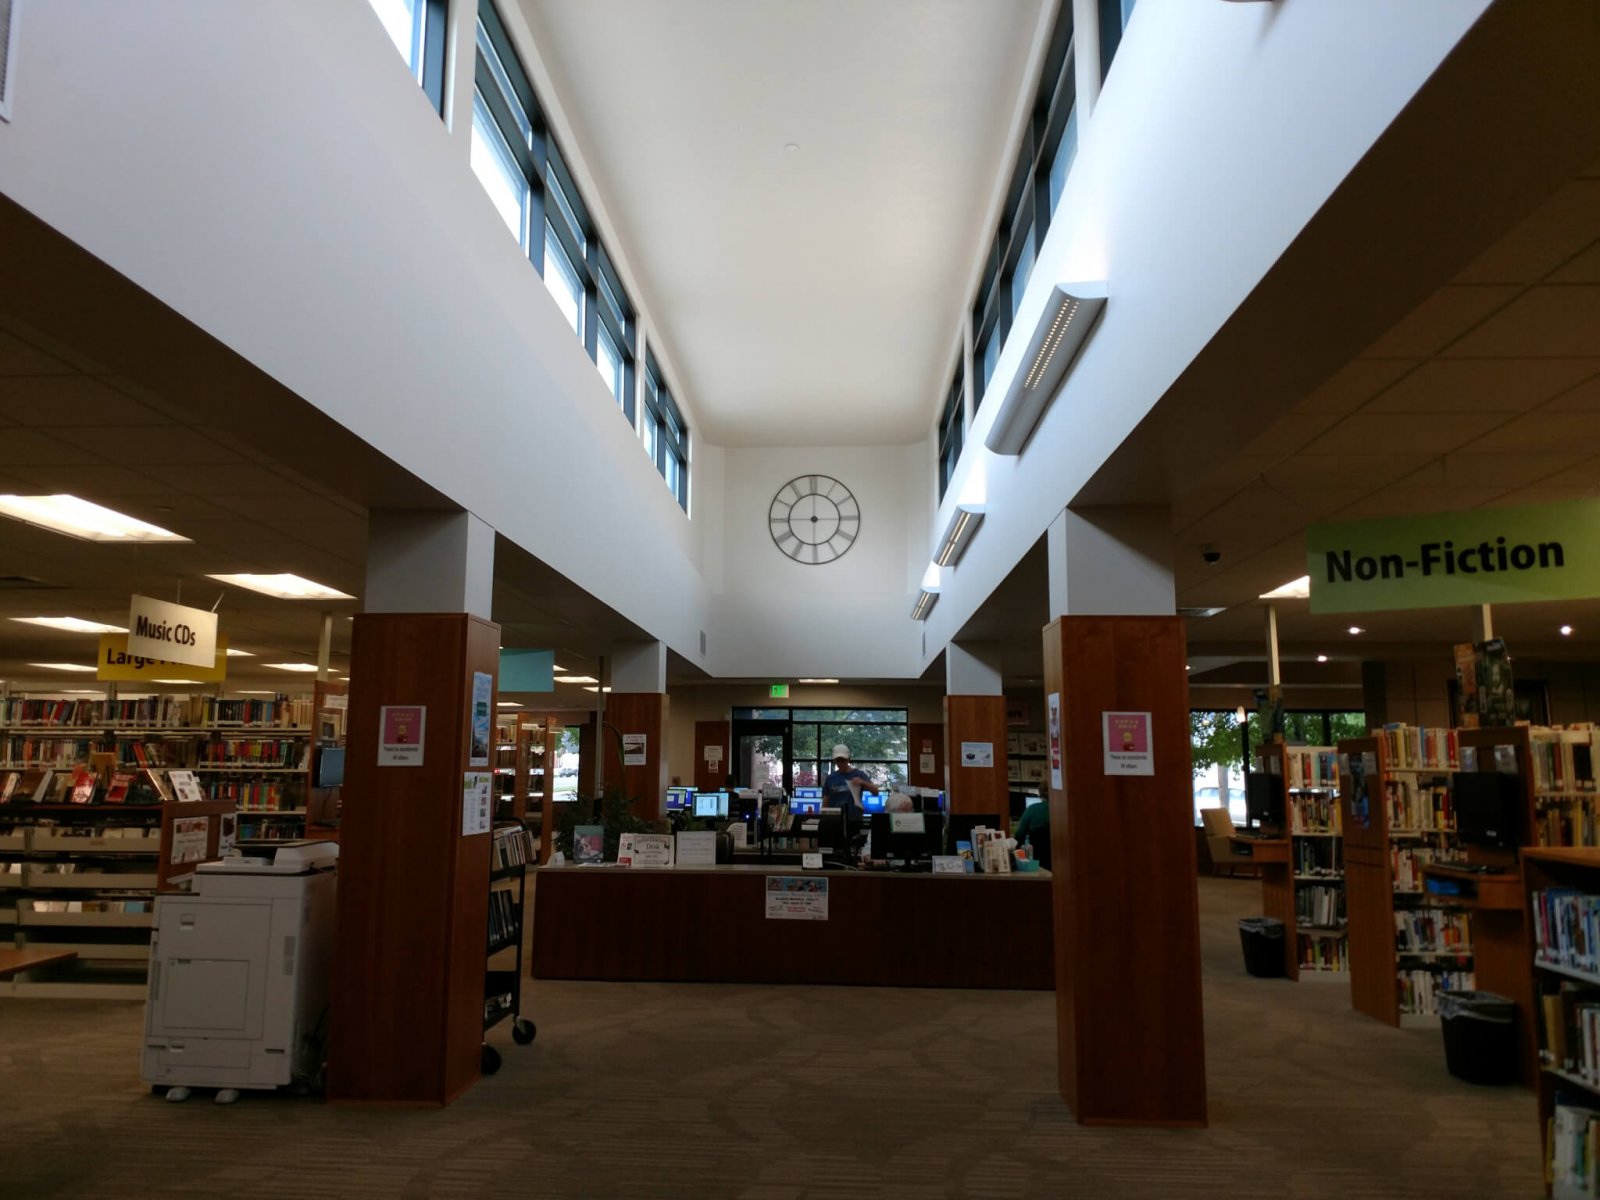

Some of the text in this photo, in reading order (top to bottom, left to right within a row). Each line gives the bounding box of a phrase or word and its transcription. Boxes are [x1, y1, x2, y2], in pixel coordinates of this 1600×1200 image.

[1326, 536, 1565, 583] Non-Fiction
[135, 615, 196, 647] Music CDs
